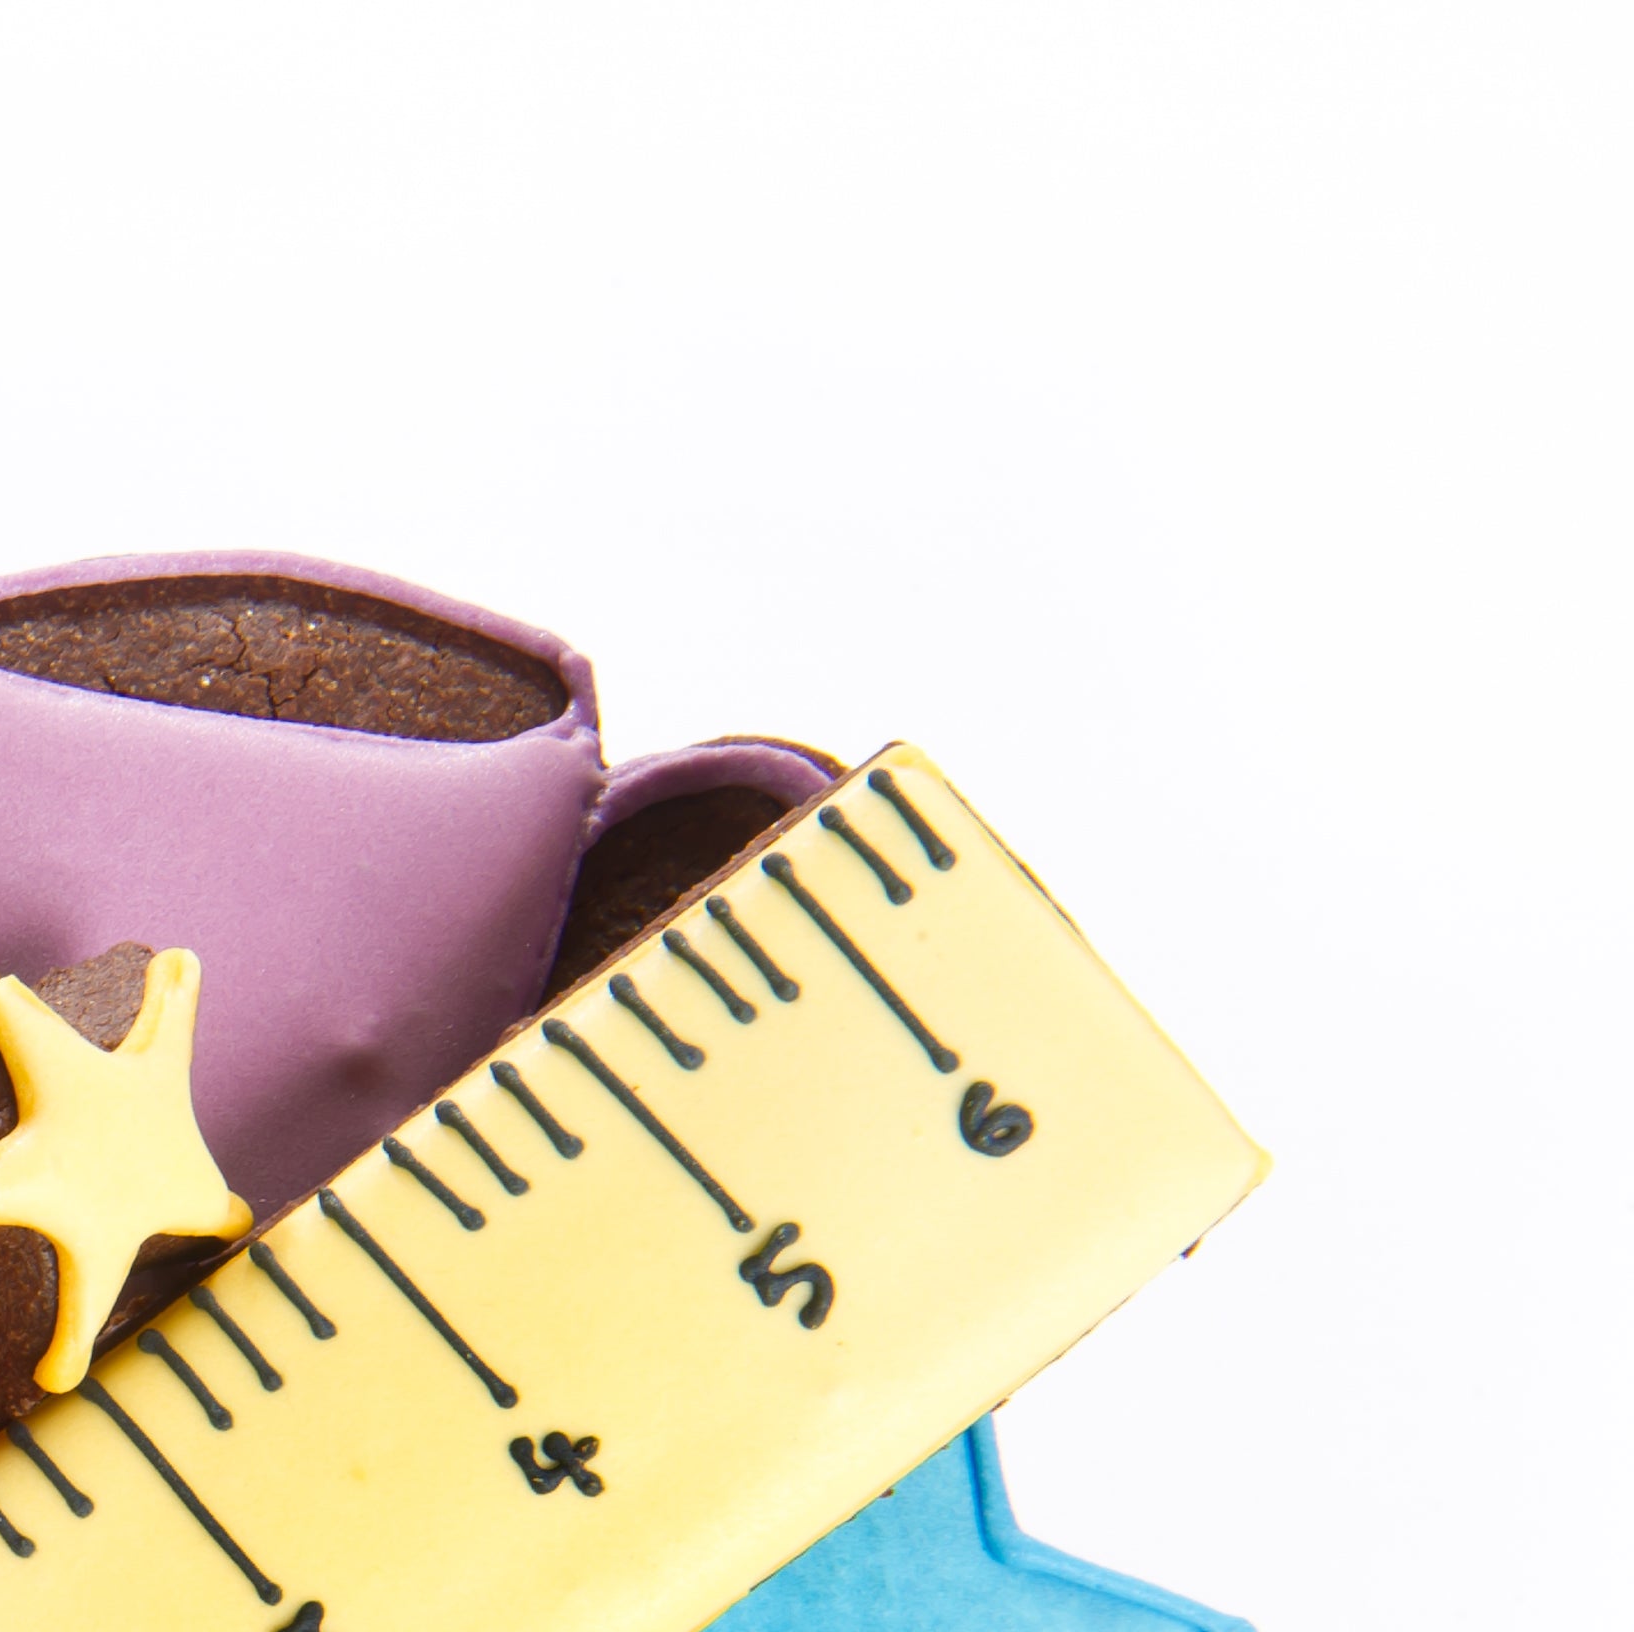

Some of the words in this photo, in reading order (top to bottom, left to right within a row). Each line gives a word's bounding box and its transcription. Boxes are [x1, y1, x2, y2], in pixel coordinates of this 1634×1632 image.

[509, 1431, 604, 1496] 4
[738, 1223, 835, 1328] 5
[958, 1081, 1033, 1156] 6
